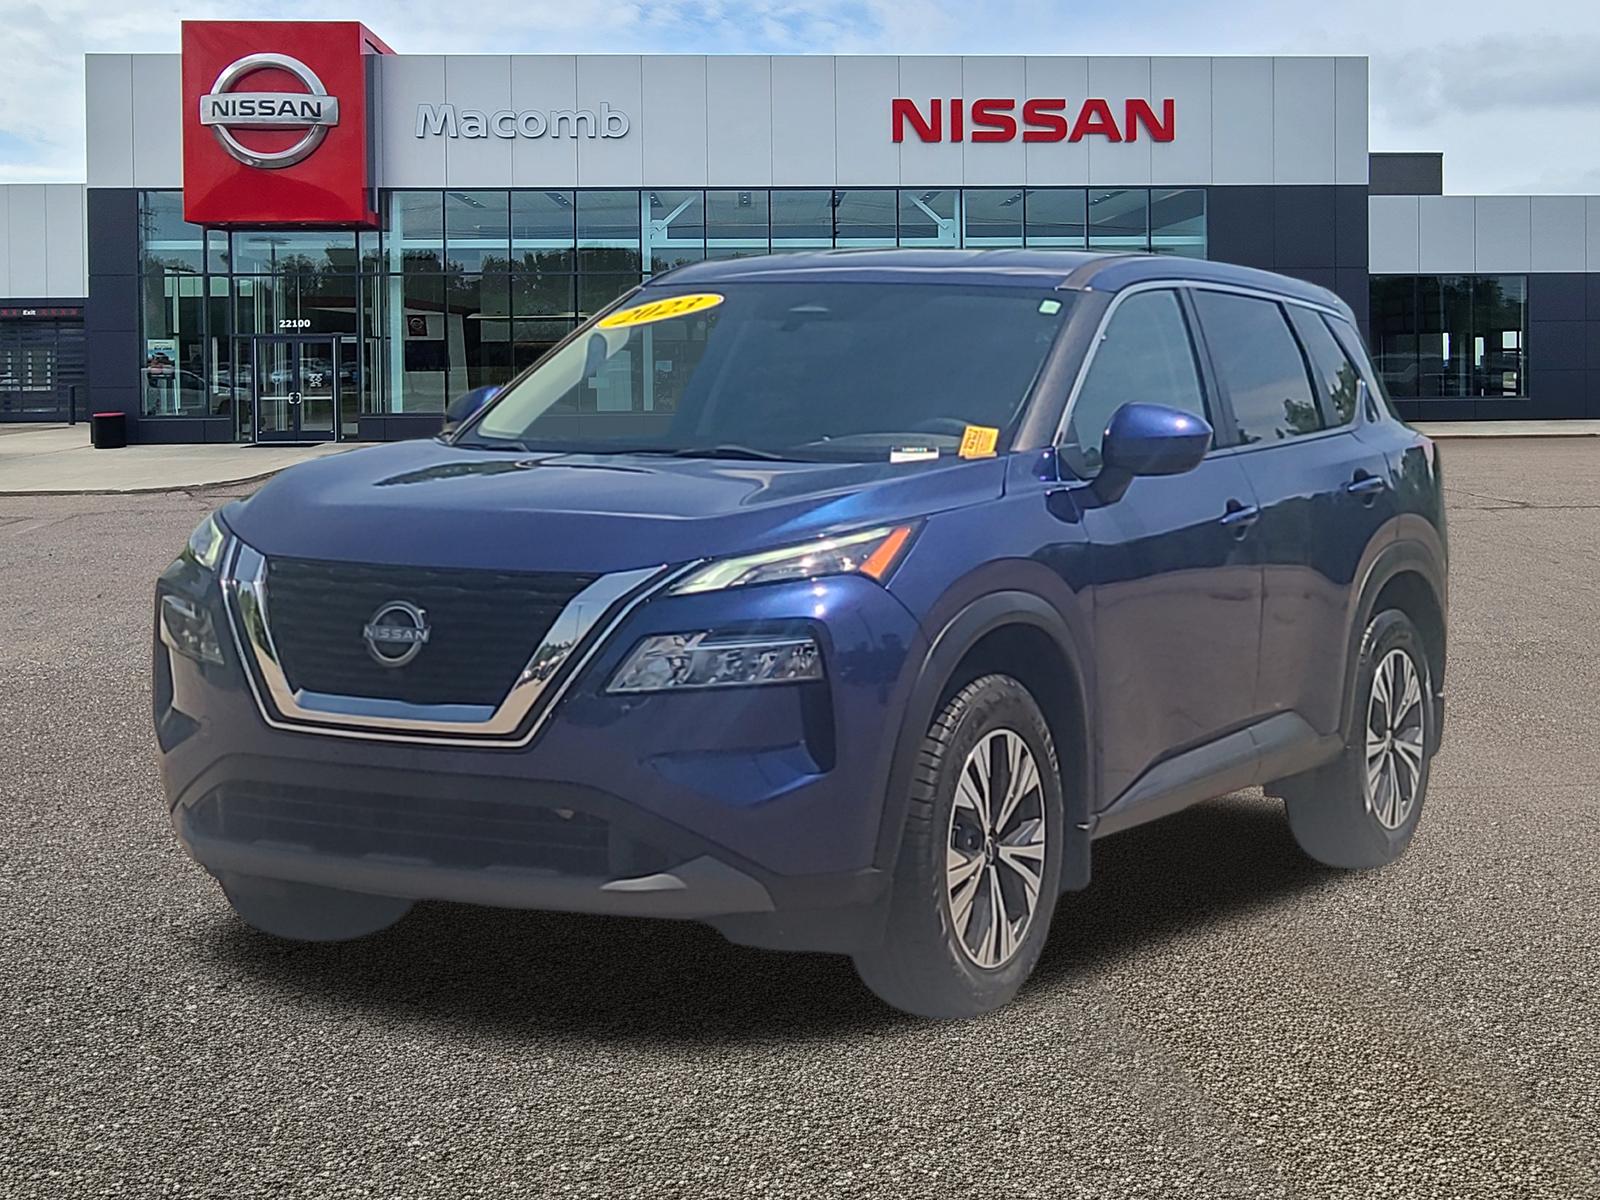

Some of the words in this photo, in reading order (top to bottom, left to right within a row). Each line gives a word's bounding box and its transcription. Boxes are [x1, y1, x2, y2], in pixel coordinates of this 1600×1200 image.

[212, 100, 321, 117] NISSAN
[415, 102, 630, 139] Macomb
[892, 98, 1176, 143] NISSAN
[612, 296, 704, 325] 2023
[279, 319, 311, 328] 22100
[364, 625, 428, 642] NISSAN
